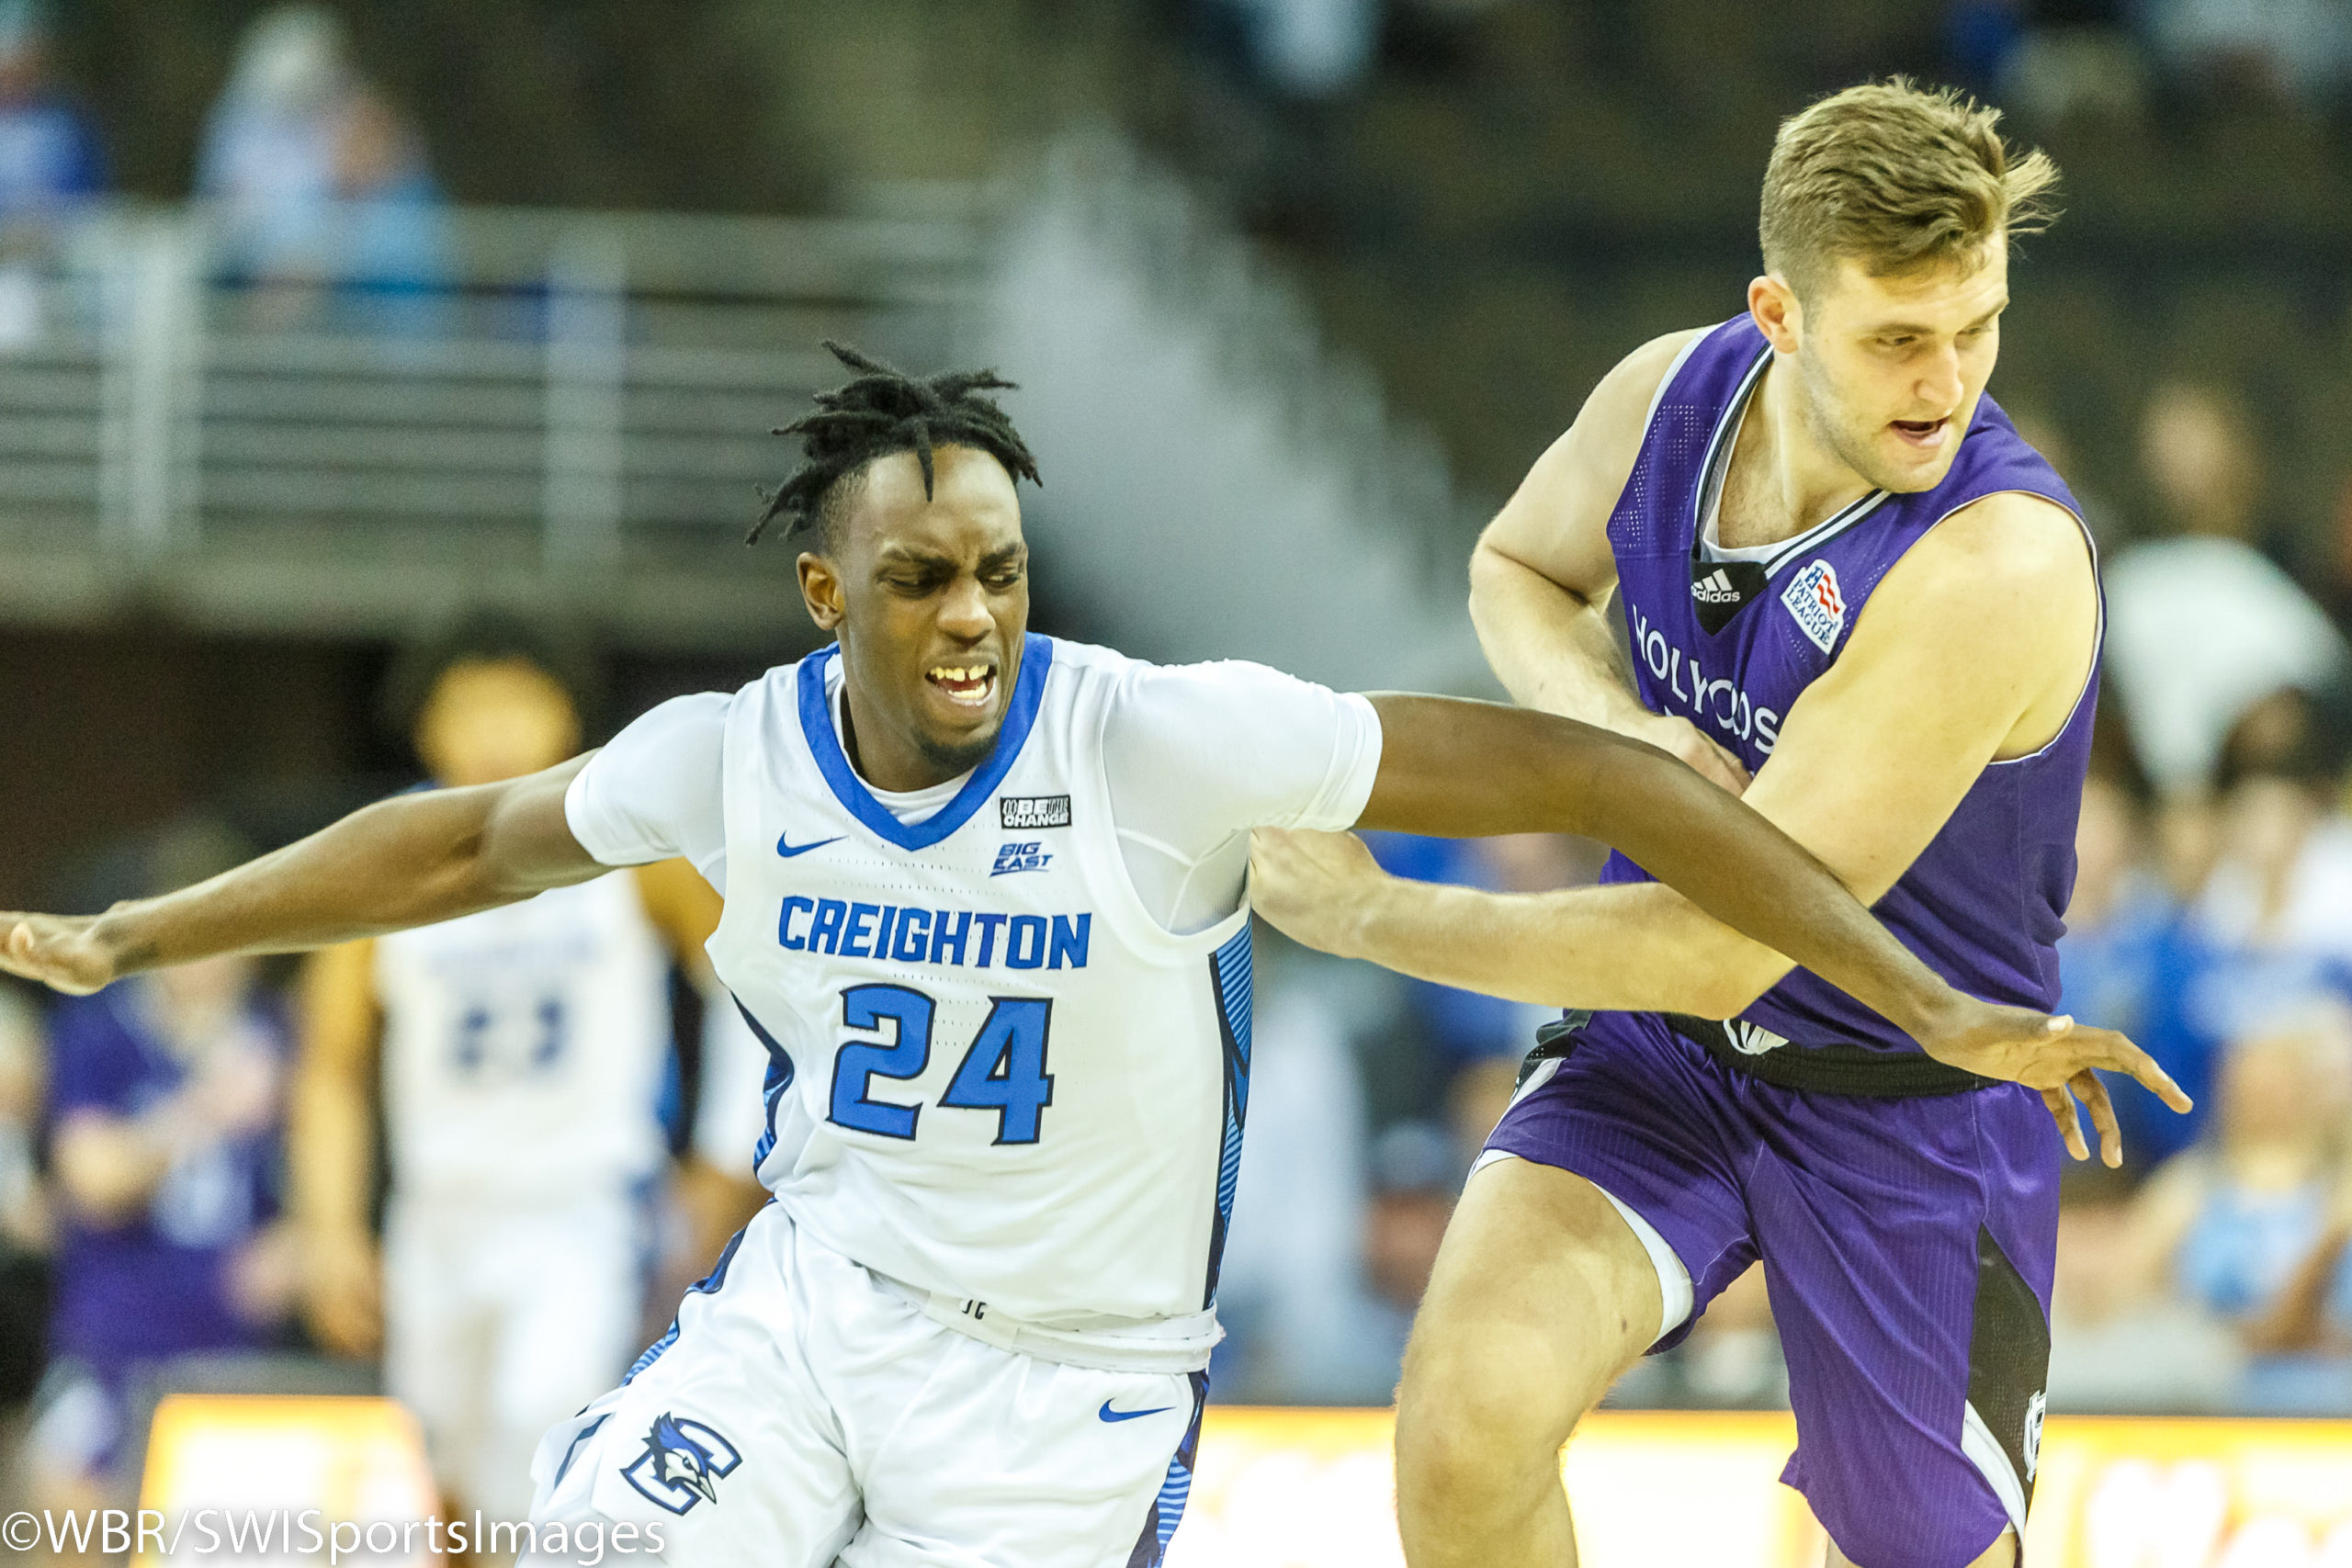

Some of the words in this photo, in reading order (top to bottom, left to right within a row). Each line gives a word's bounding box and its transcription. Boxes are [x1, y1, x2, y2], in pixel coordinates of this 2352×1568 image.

[1690, 585, 1741, 603] adidas
[1786, 588, 1830, 645] LEAGUE
[1793, 578, 1838, 634] PATRIOT
[1633, 604, 1708, 714] HOLY
[1003, 813, 1069, 828] CHANGE
[993, 854, 1054, 871] EAST
[999, 842, 1042, 857] BIG
[779, 896, 1091, 970] CREIGHTON
[826, 983, 1055, 1146] 24
